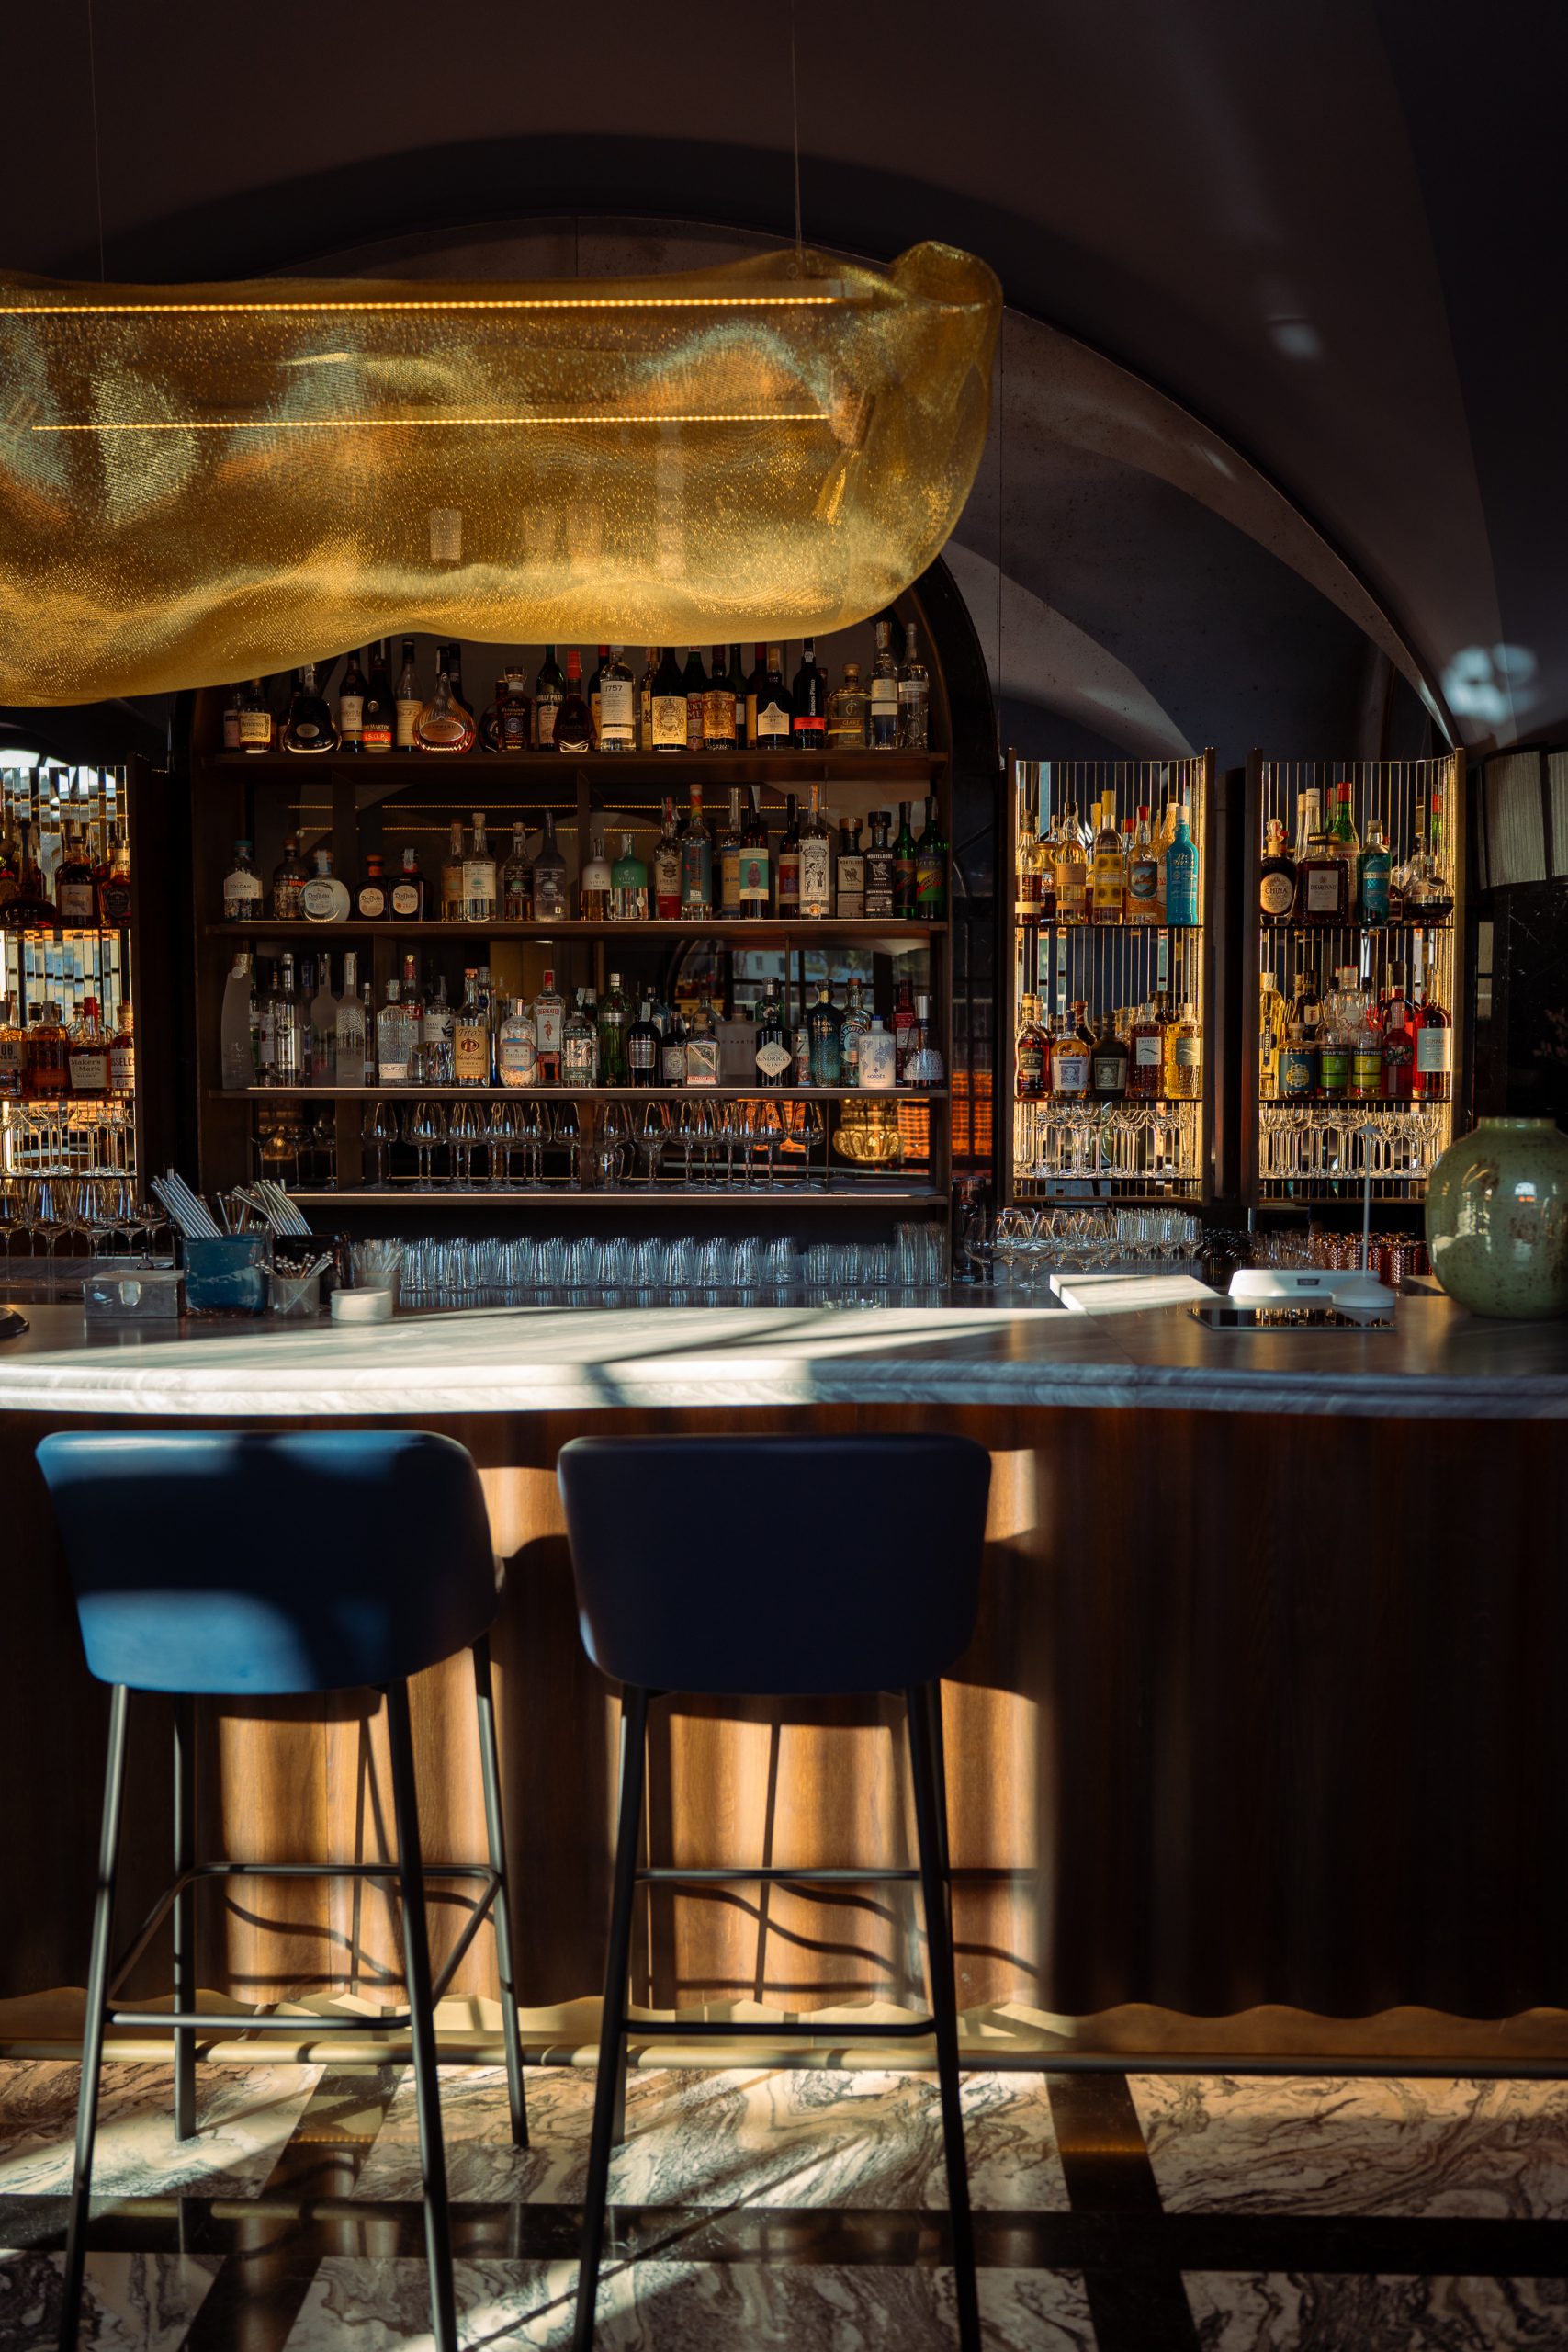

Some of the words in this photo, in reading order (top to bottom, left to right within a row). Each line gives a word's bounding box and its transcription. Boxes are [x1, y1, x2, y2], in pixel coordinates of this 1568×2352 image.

[687, 702, 703, 710] UNT
[441, 1020, 454, 1038] 白
[458, 1028, 483, 1037] Tito's
